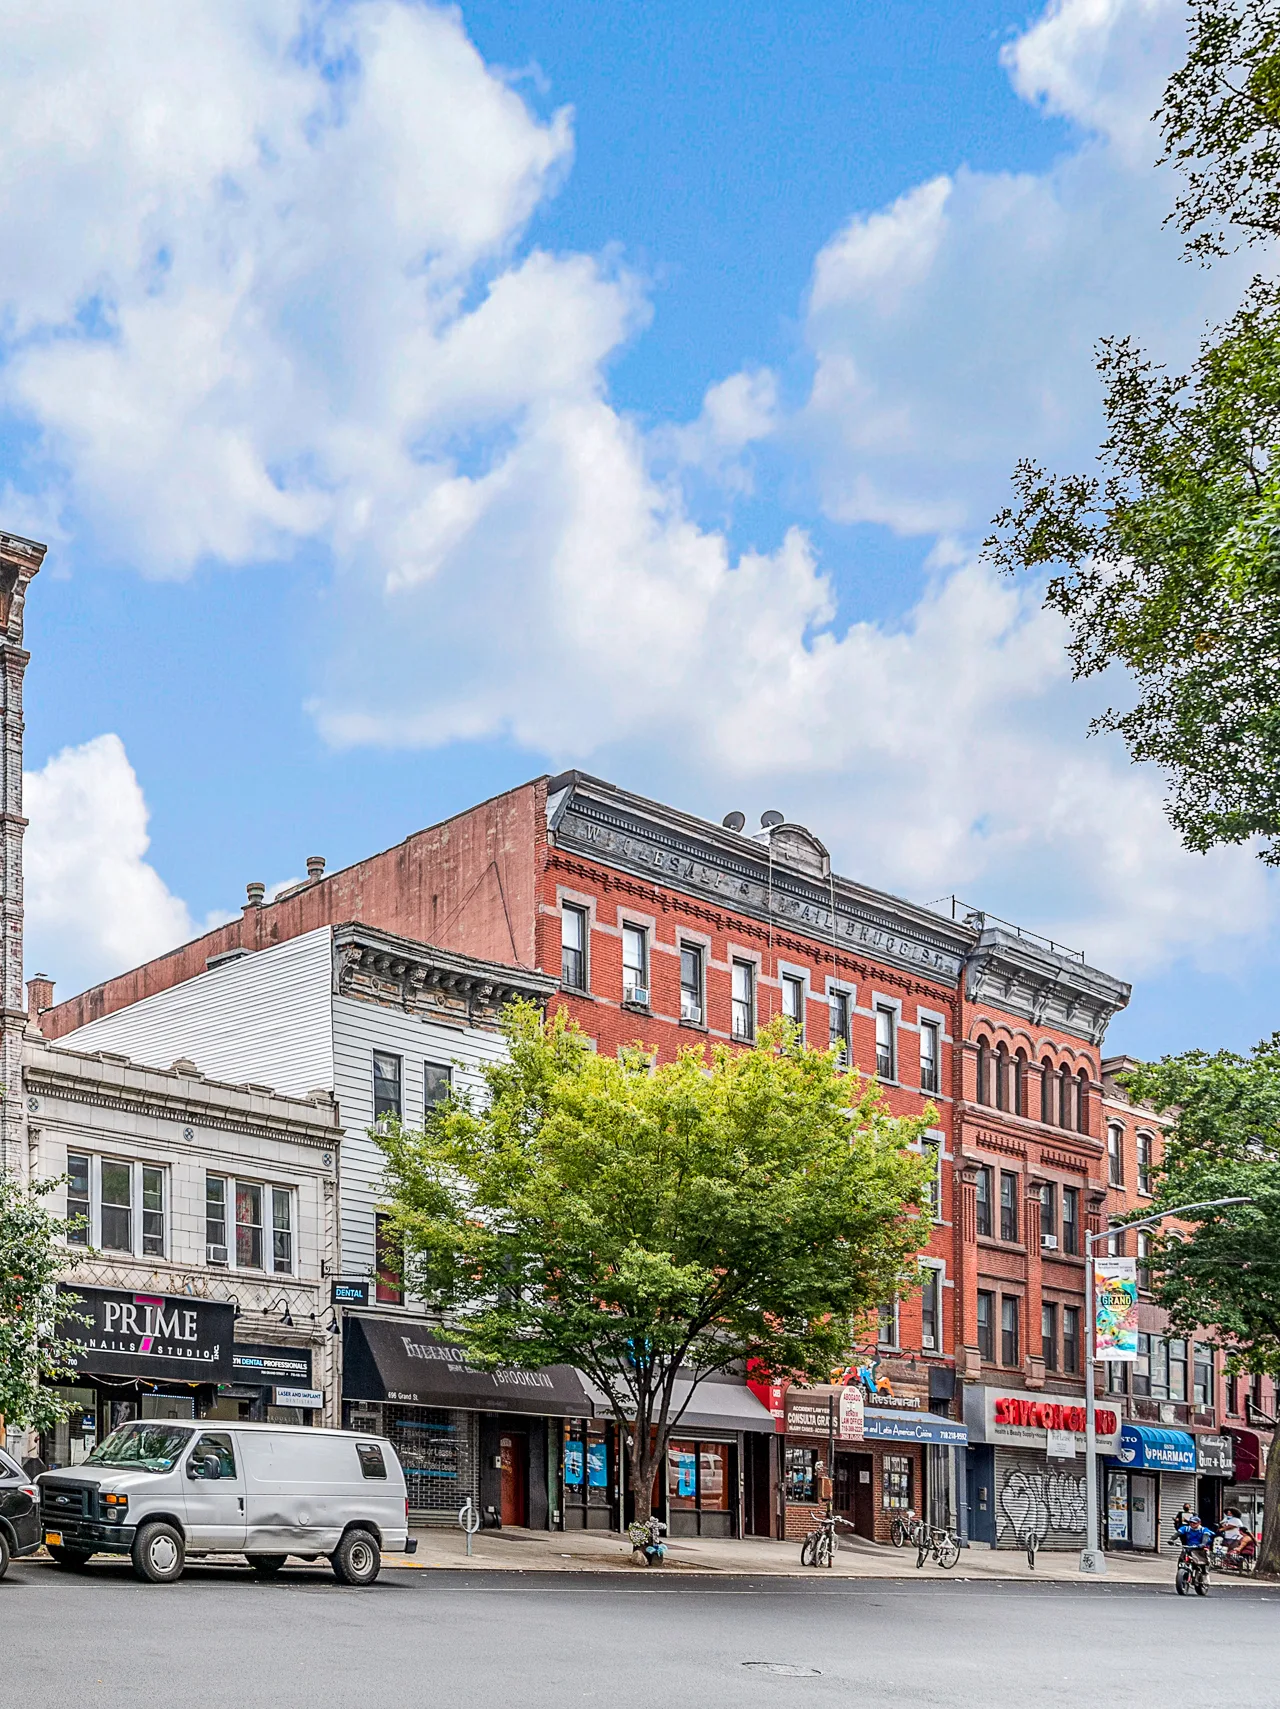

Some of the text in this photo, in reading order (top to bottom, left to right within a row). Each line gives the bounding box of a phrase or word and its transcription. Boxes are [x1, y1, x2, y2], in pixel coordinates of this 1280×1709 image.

[336, 1289, 363, 1298] DENTAL
[1102, 1296, 1131, 1305] GRAND
[103, 1301, 198, 1341] PRIME
[90, 1339, 210, 1358] NAILS STUDIO
[67, 1358, 78, 1366] 700
[241, 1358, 264, 1366] DENTAL
[264, 1360, 308, 1370] PROFESSIONALS
[496, 1370, 554, 1388] BROOKLYN
[398, 1392, 412, 1400] Grand
[872, 1393, 921, 1408] Restaurant
[788, 1412, 838, 1427] CONSULTA GRAIS
[995, 1398, 1037, 1427] SAVE
[1064, 1406, 1117, 1435] GRND
[879, 1422, 893, 1435] Latin
[893, 1424, 915, 1436] American
[915, 1425, 932, 1438] Cuisine
[1152, 1449, 1193, 1463] PHARMACY
